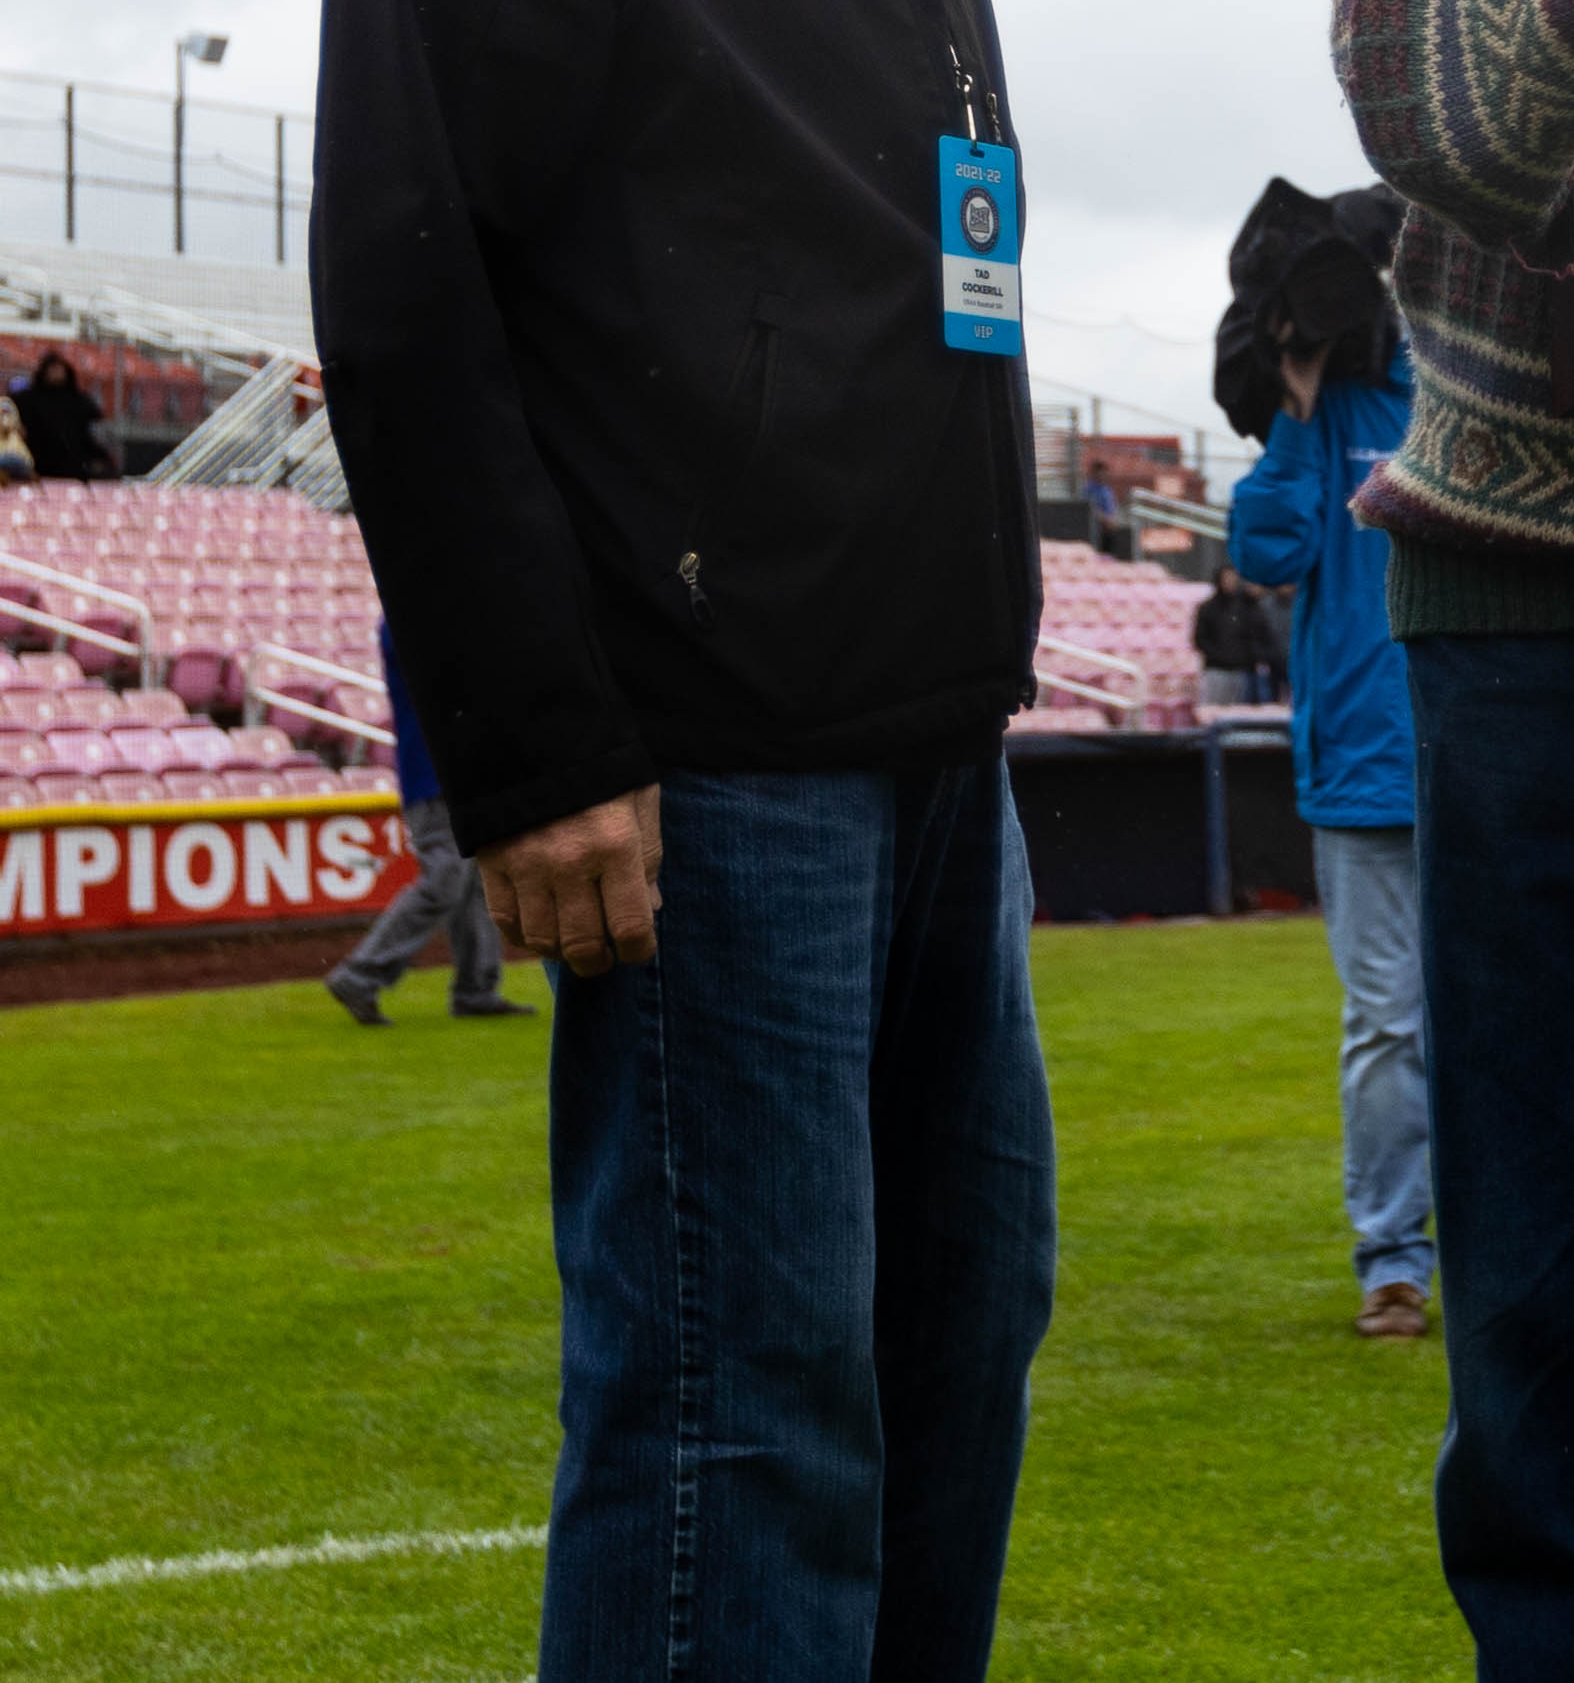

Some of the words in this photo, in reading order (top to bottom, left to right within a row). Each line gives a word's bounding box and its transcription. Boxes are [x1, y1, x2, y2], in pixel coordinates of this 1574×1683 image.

[956, 163, 1001, 184] 2021-22
[975, 268, 990, 279] TAD
[975, 325, 993, 338] VIP
